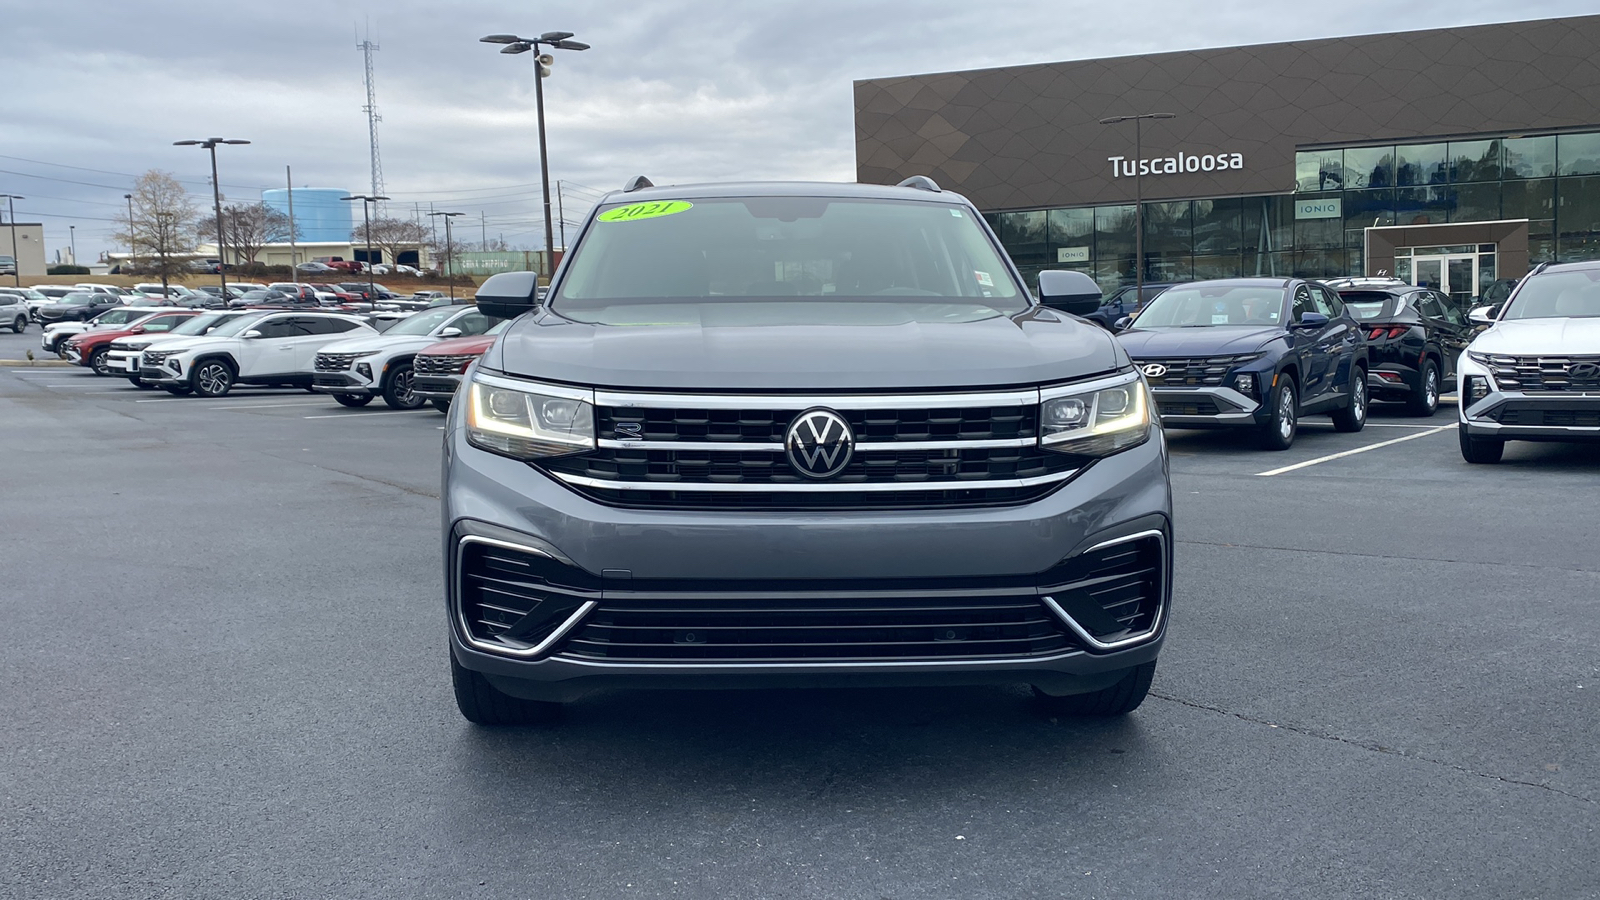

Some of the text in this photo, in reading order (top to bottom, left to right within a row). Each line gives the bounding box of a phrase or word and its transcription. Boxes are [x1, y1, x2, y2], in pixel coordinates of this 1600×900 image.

[1107, 152, 1244, 178] Tuscaloosa
[611, 202, 674, 220] 2021
[1300, 204, 1336, 214] IONIQ
[481, 259, 508, 269] SHIPPING
